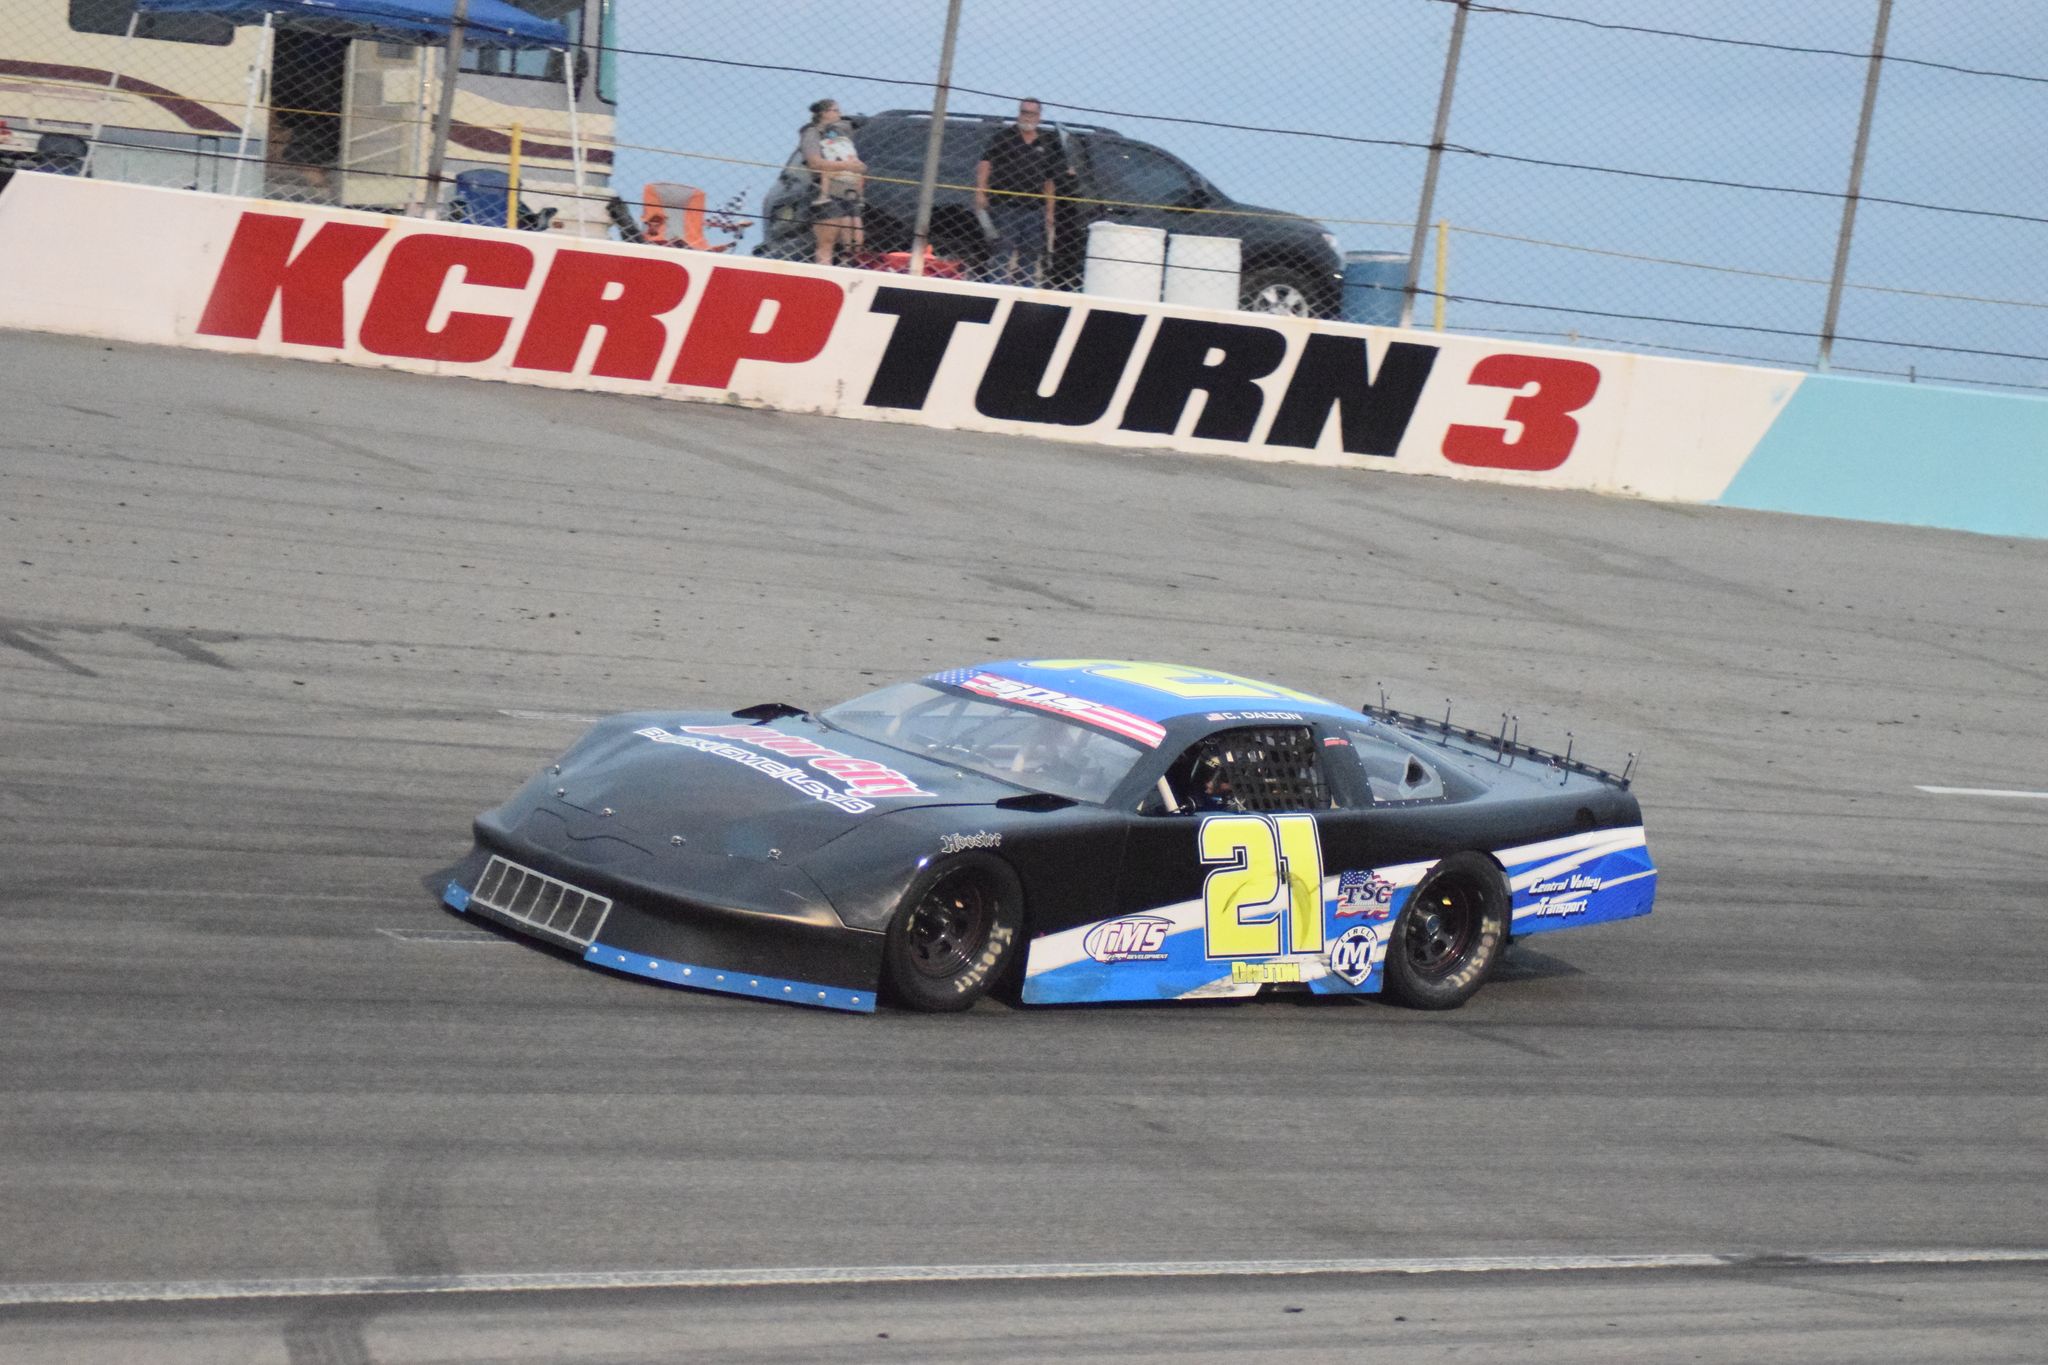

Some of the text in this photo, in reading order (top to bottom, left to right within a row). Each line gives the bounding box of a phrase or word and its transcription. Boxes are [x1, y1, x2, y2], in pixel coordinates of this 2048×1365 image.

[196, 211, 1601, 471] KCRP TURN 3
[1242, 711, 1303, 721] DALTON
[808, 758, 938, 797] City
[941, 830, 1002, 853] Hoosier
[1198, 813, 1325, 960] 21
[1570, 874, 1601, 891] Valley
[1537, 896, 1588, 917] Transport
